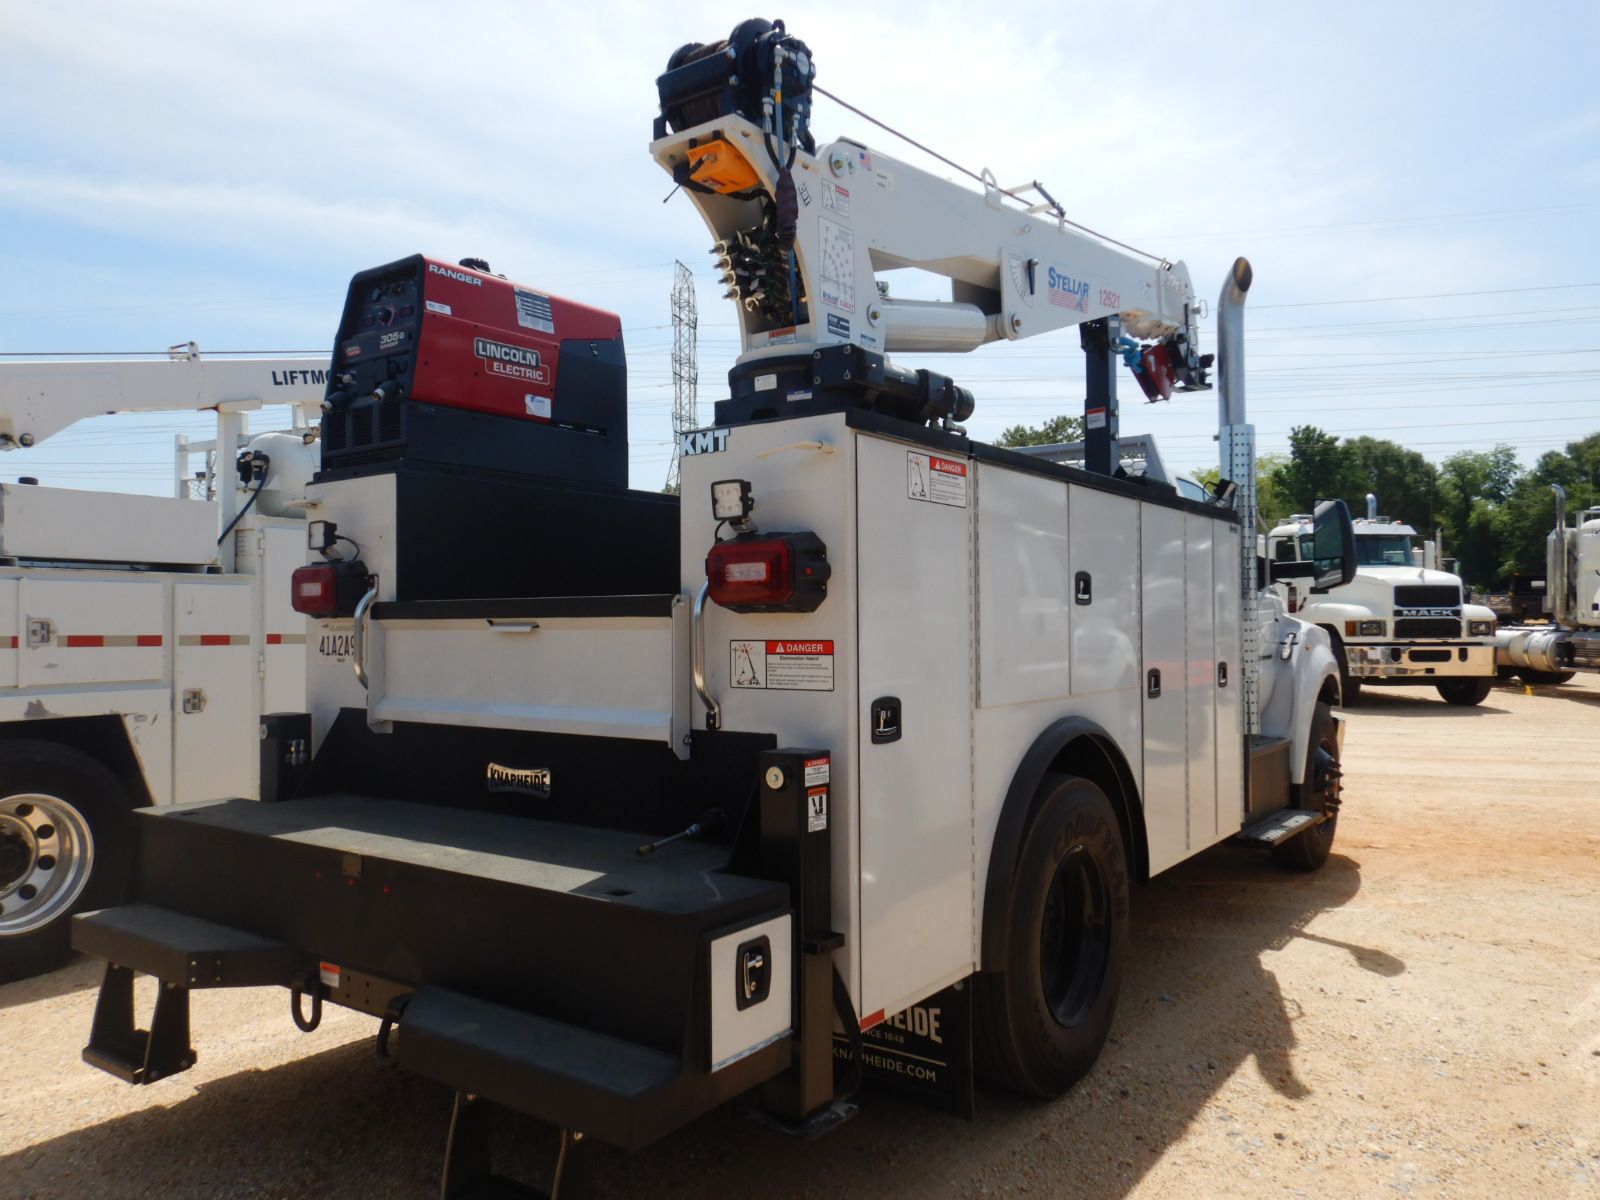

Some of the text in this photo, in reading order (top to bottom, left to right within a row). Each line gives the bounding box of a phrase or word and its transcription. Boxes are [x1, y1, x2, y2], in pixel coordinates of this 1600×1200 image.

[428, 263, 482, 287] RANGER
[1099, 288, 1120, 310] 12621
[478, 341, 537, 366] LINCOLN
[493, 361, 543, 381] ELECTRIC
[680, 428, 730, 457] KMT
[786, 644, 823, 652] DANGER
[490, 767, 548, 789] KNAPHEIDE
[882, 1006, 943, 1044] EIDE
[884, 1032, 905, 1043] 1848
